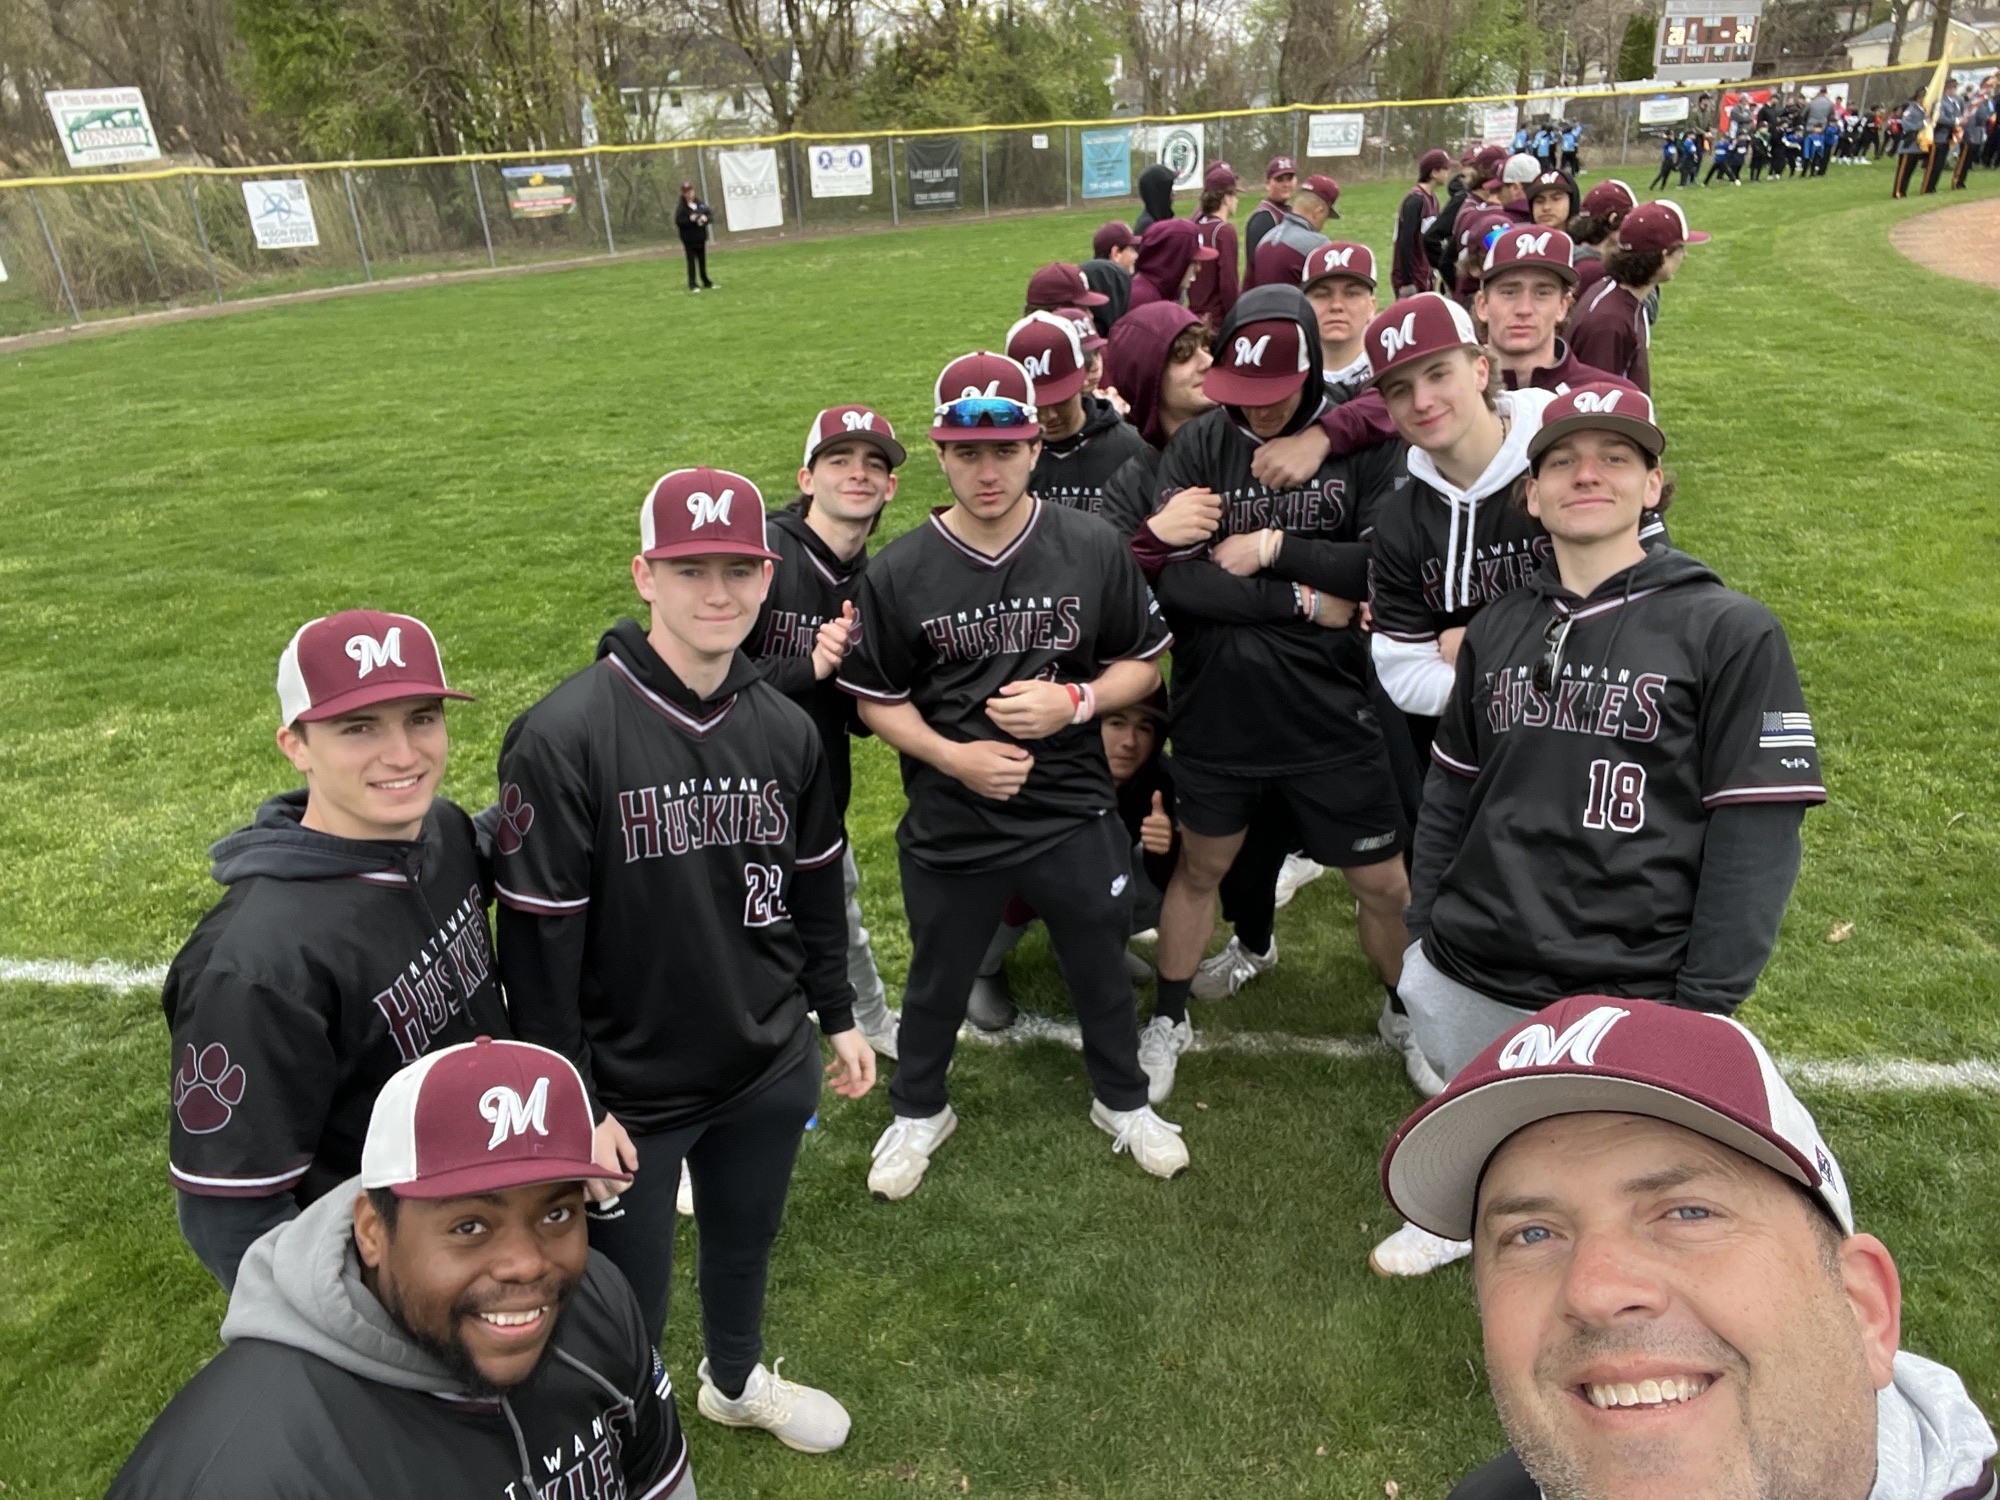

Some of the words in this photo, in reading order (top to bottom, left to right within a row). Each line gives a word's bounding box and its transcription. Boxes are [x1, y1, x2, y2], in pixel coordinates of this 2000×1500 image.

[1324, 247, 1354, 272] M
[1515, 231, 1552, 259] M
[1234, 335, 1272, 367] M
[1380, 312, 1417, 362] M
[1023, 348, 1052, 380] M
[1573, 389, 1624, 413] M
[841, 410, 875, 432] M
[686, 489, 735, 532] M
[957, 597, 1052, 624] MATAWAN
[921, 596, 1081, 664] HUSKIES
[345, 626, 406, 680] M
[1518, 663, 1631, 684] MAWAN
[1583, 759, 1646, 833] 18
[618, 779, 789, 864] HUSKIES
[1498, 1005, 1630, 1071] M
[479, 1076, 550, 1151] M
